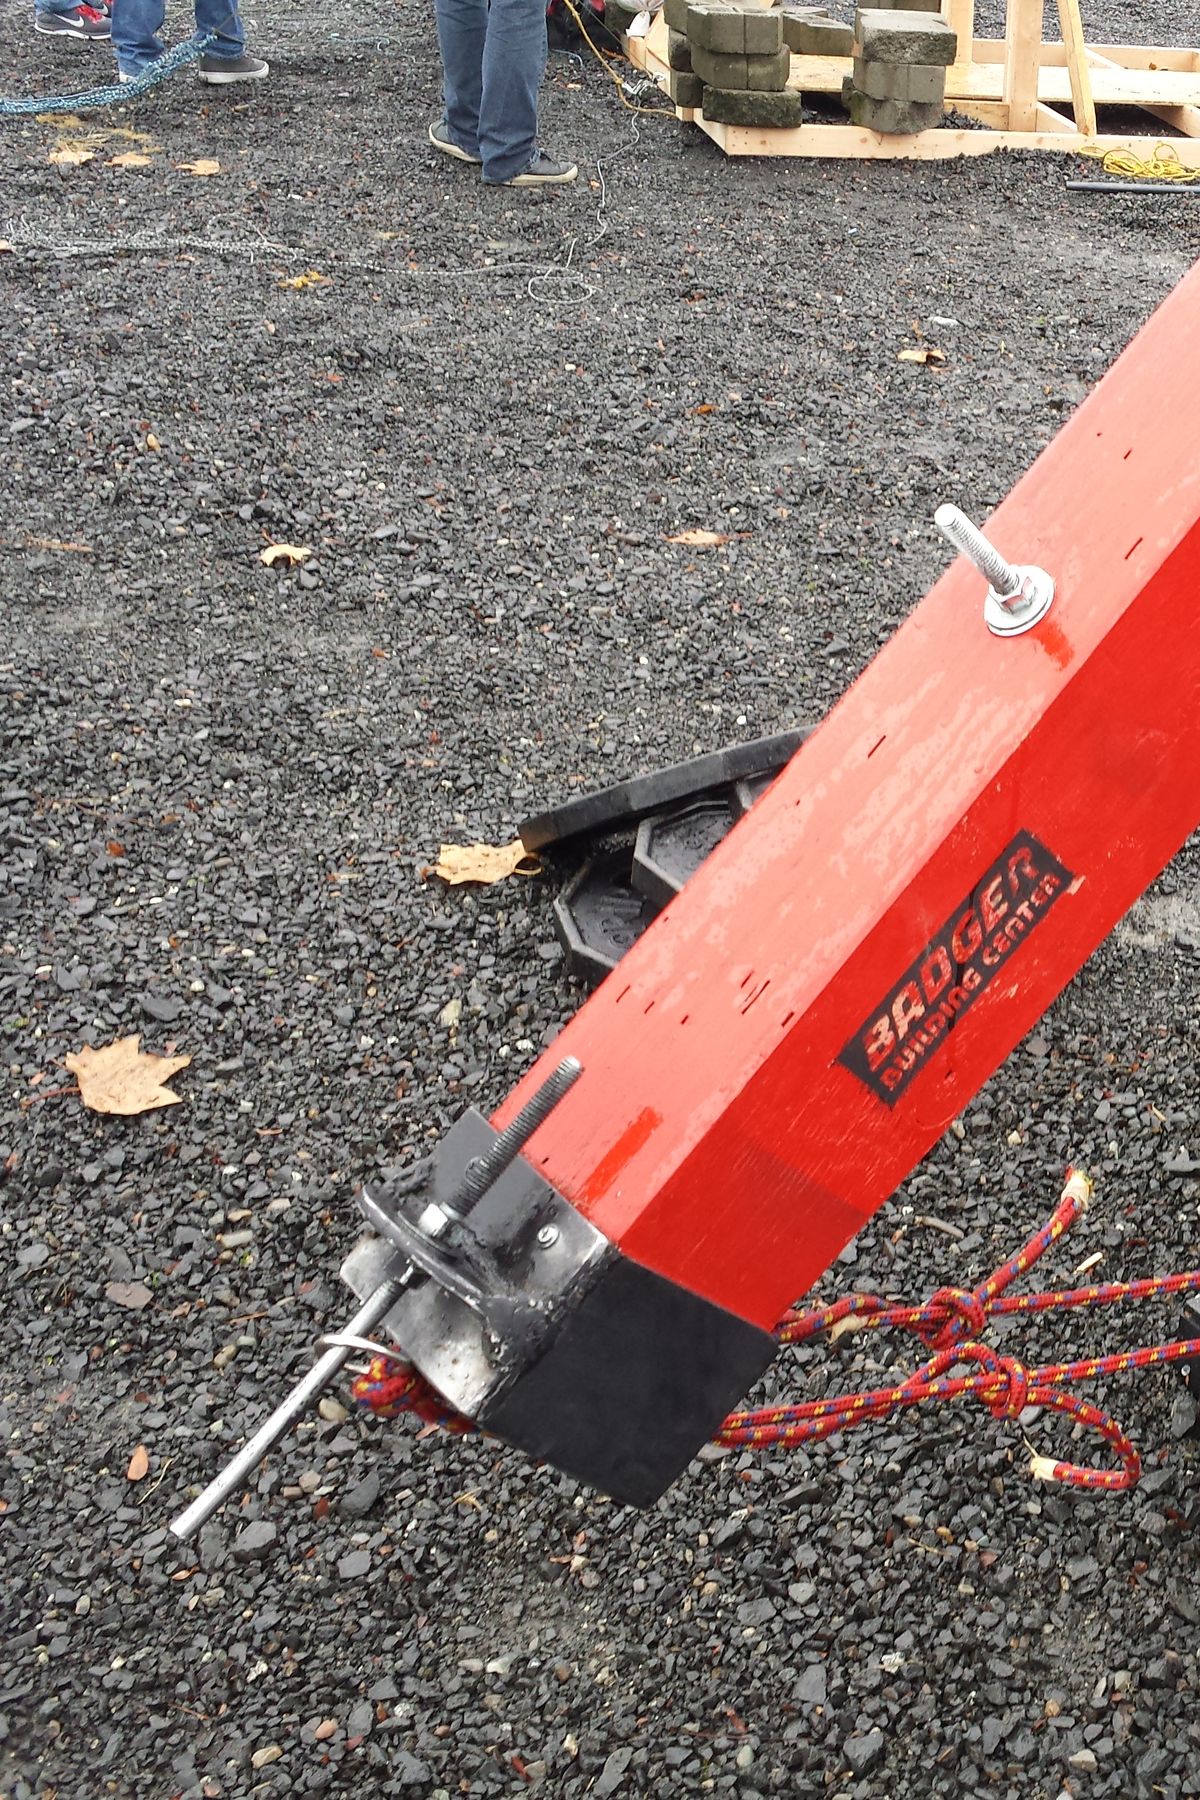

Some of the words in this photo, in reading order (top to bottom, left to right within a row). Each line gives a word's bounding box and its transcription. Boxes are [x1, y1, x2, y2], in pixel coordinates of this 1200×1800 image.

[862, 847, 1038, 1072] BADGER
[880, 967, 983, 1091] BUILDING
[982, 874, 1061, 967] CENTER
